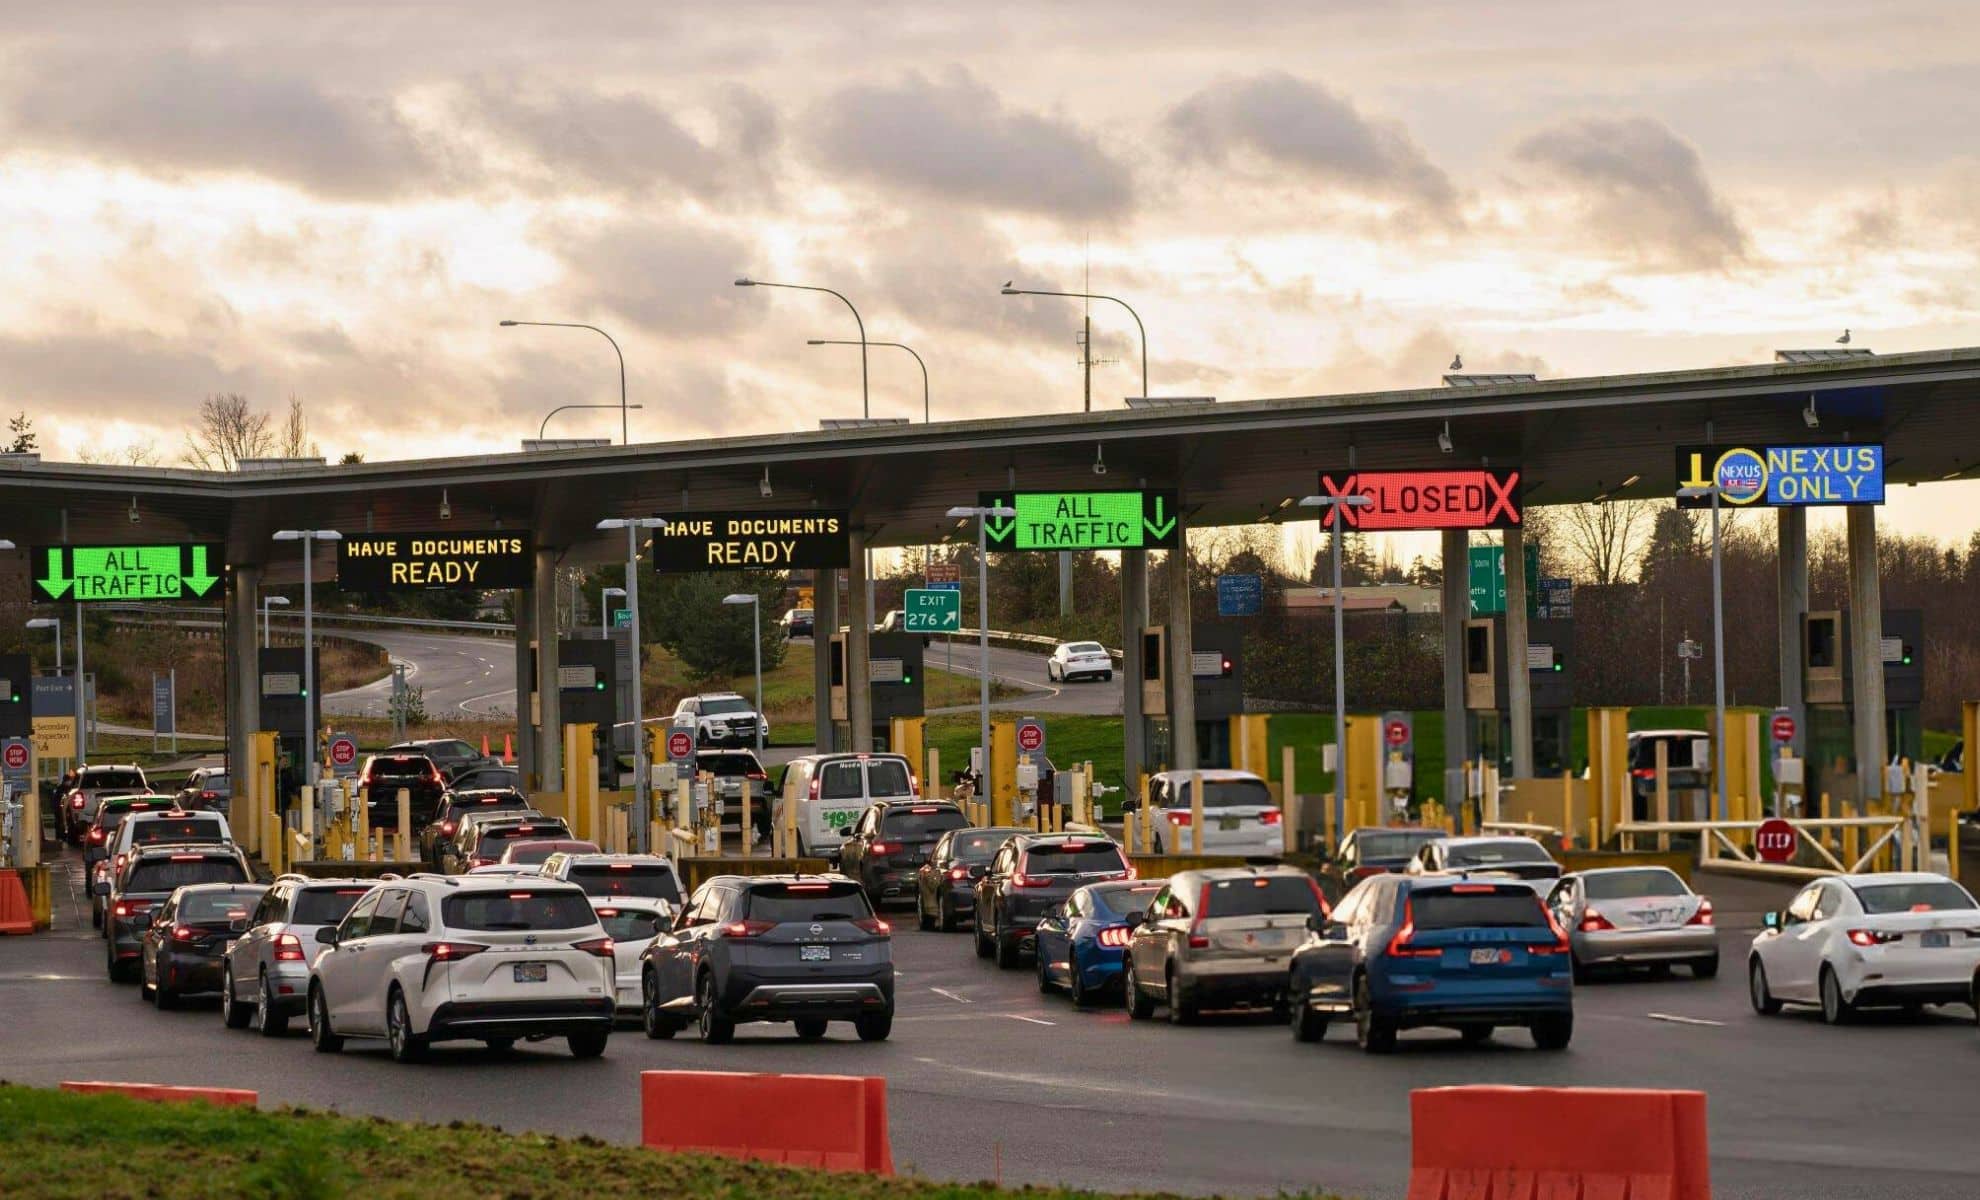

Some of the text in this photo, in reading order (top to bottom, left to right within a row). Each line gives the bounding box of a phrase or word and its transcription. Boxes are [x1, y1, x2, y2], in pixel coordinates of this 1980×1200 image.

[1768, 448, 1875, 473] NEXUS
[1721, 465, 1760, 478] NEXUS
[1778, 475, 1864, 500] ONLY
[1056, 497, 1101, 518] ALL
[1359, 485, 1483, 513] CLOSED
[664, 519, 839, 536] HAVE DOCUMENTS
[1029, 522, 1129, 544] TRAFFIC
[348, 539, 522, 556] HAVE DOCUMENTS
[707, 540, 796, 564] READY
[105, 550, 149, 570] ALL
[391, 560, 479, 584] READY
[76, 574, 178, 596] TRAFFIC
[920, 595, 946, 606] EXIT
[908, 613, 938, 626] 276
